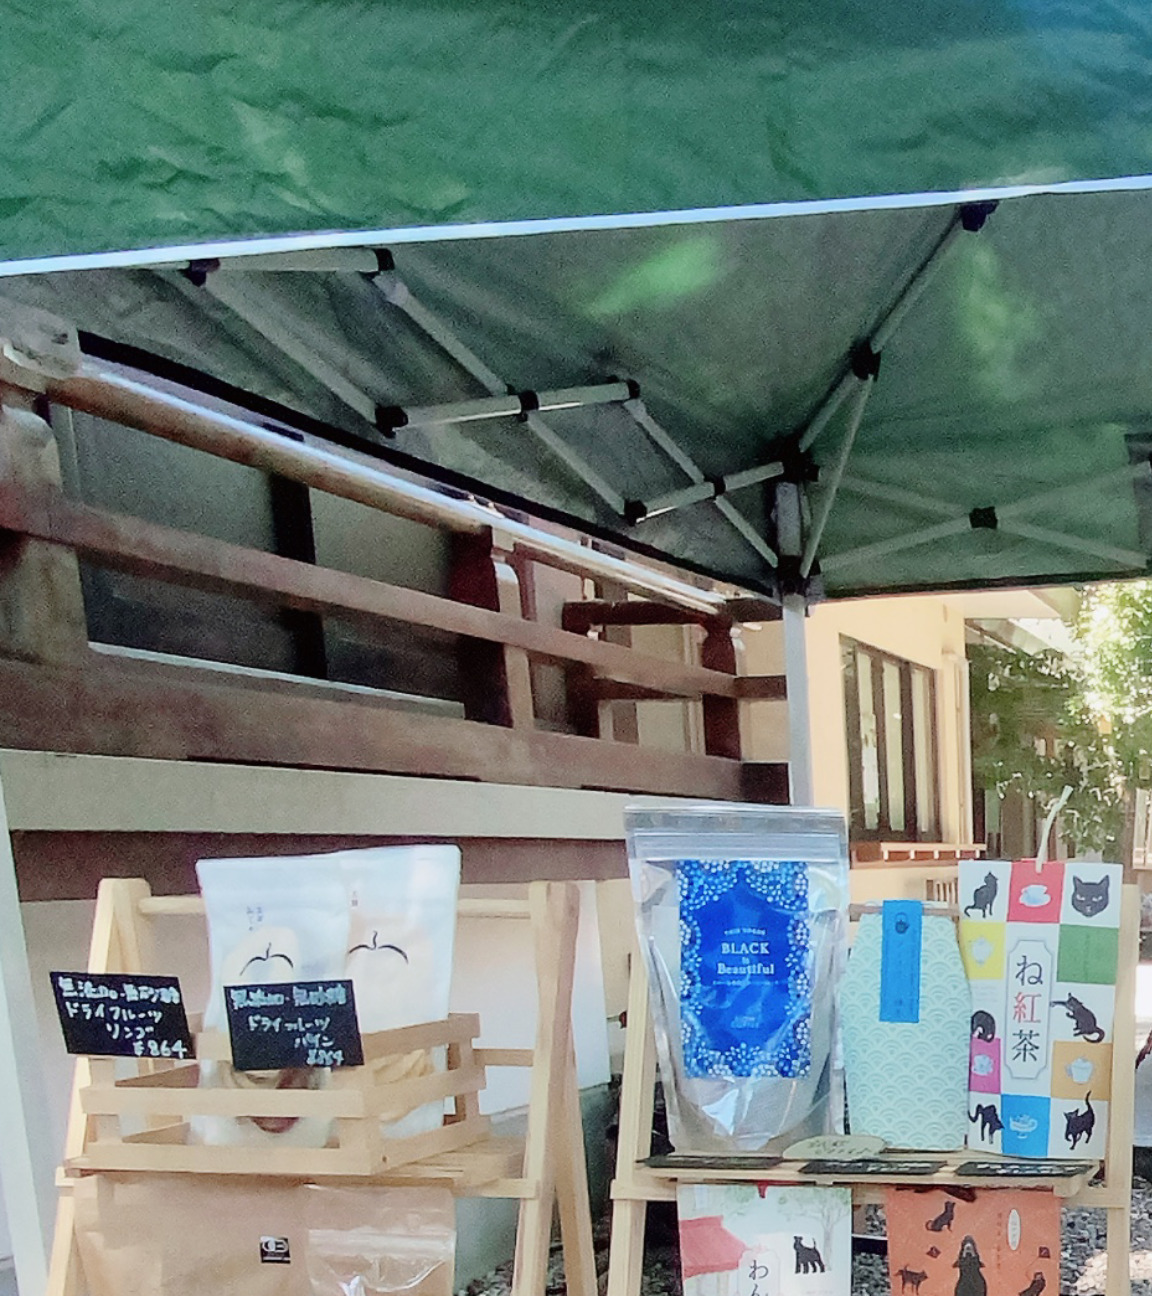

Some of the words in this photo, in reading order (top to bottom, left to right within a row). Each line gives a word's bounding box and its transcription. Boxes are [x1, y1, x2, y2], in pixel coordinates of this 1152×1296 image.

[721, 942, 770, 954] BLACK
[717, 962, 775, 975] Beautiful
[65, 1001, 163, 1023] ドライフルーツ
[1012, 954, 1044, 1063] ね紅茶
[105, 1022, 155, 1040] リンゴ
